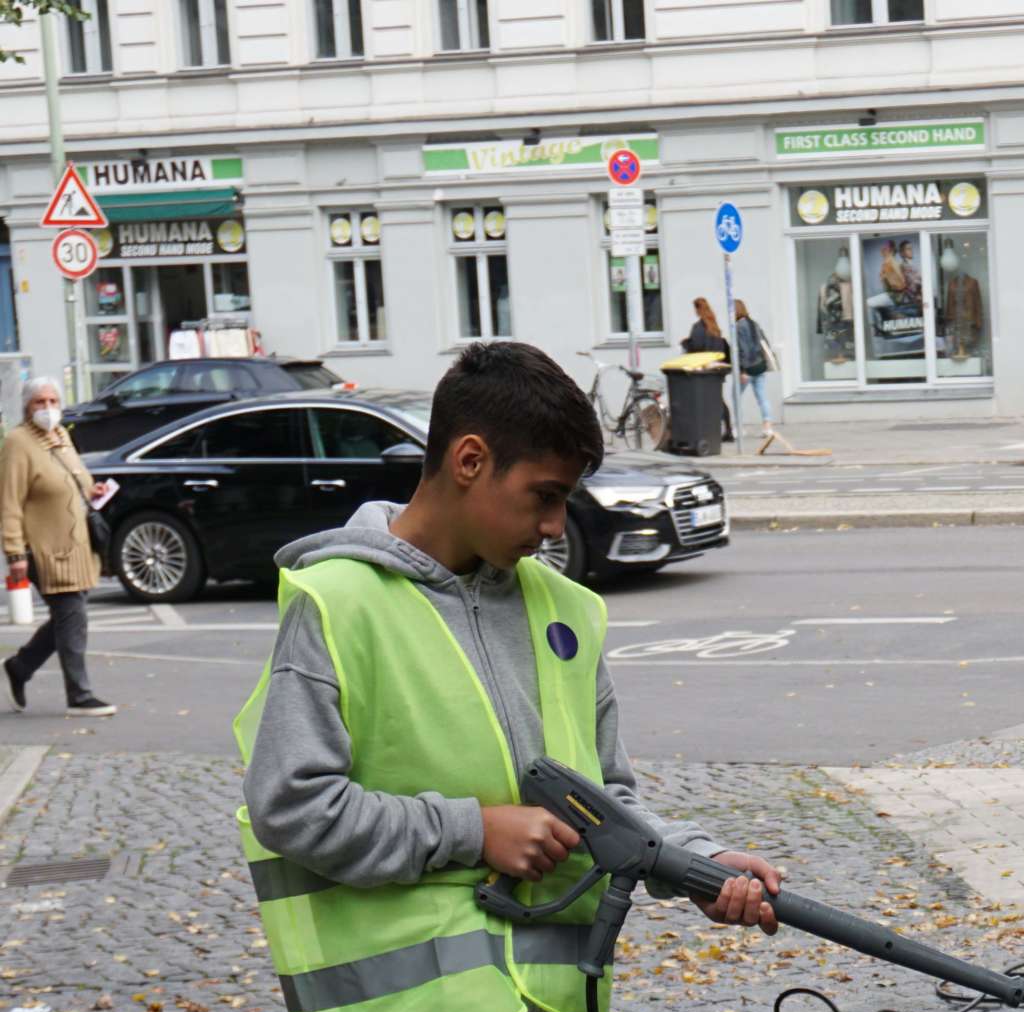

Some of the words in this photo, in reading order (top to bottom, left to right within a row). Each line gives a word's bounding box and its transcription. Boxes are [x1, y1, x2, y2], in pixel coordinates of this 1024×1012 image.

[783, 135, 820, 149] FIRST
[823, 132, 868, 147] CLASS
[871, 129, 930, 145] SECOND
[933, 127, 976, 142] HAND
[470, 138, 583, 170] Vintage
[94, 160, 206, 186] HUMANA
[834, 183, 943, 208] HUMANA
[836, 209, 879, 222] SECOND
[879, 207, 910, 221] HAND
[910, 206, 943, 219] MODE
[118, 221, 214, 244] HUMANA
[62, 242, 88, 263] 30
[120, 244, 157, 258] SECOND
